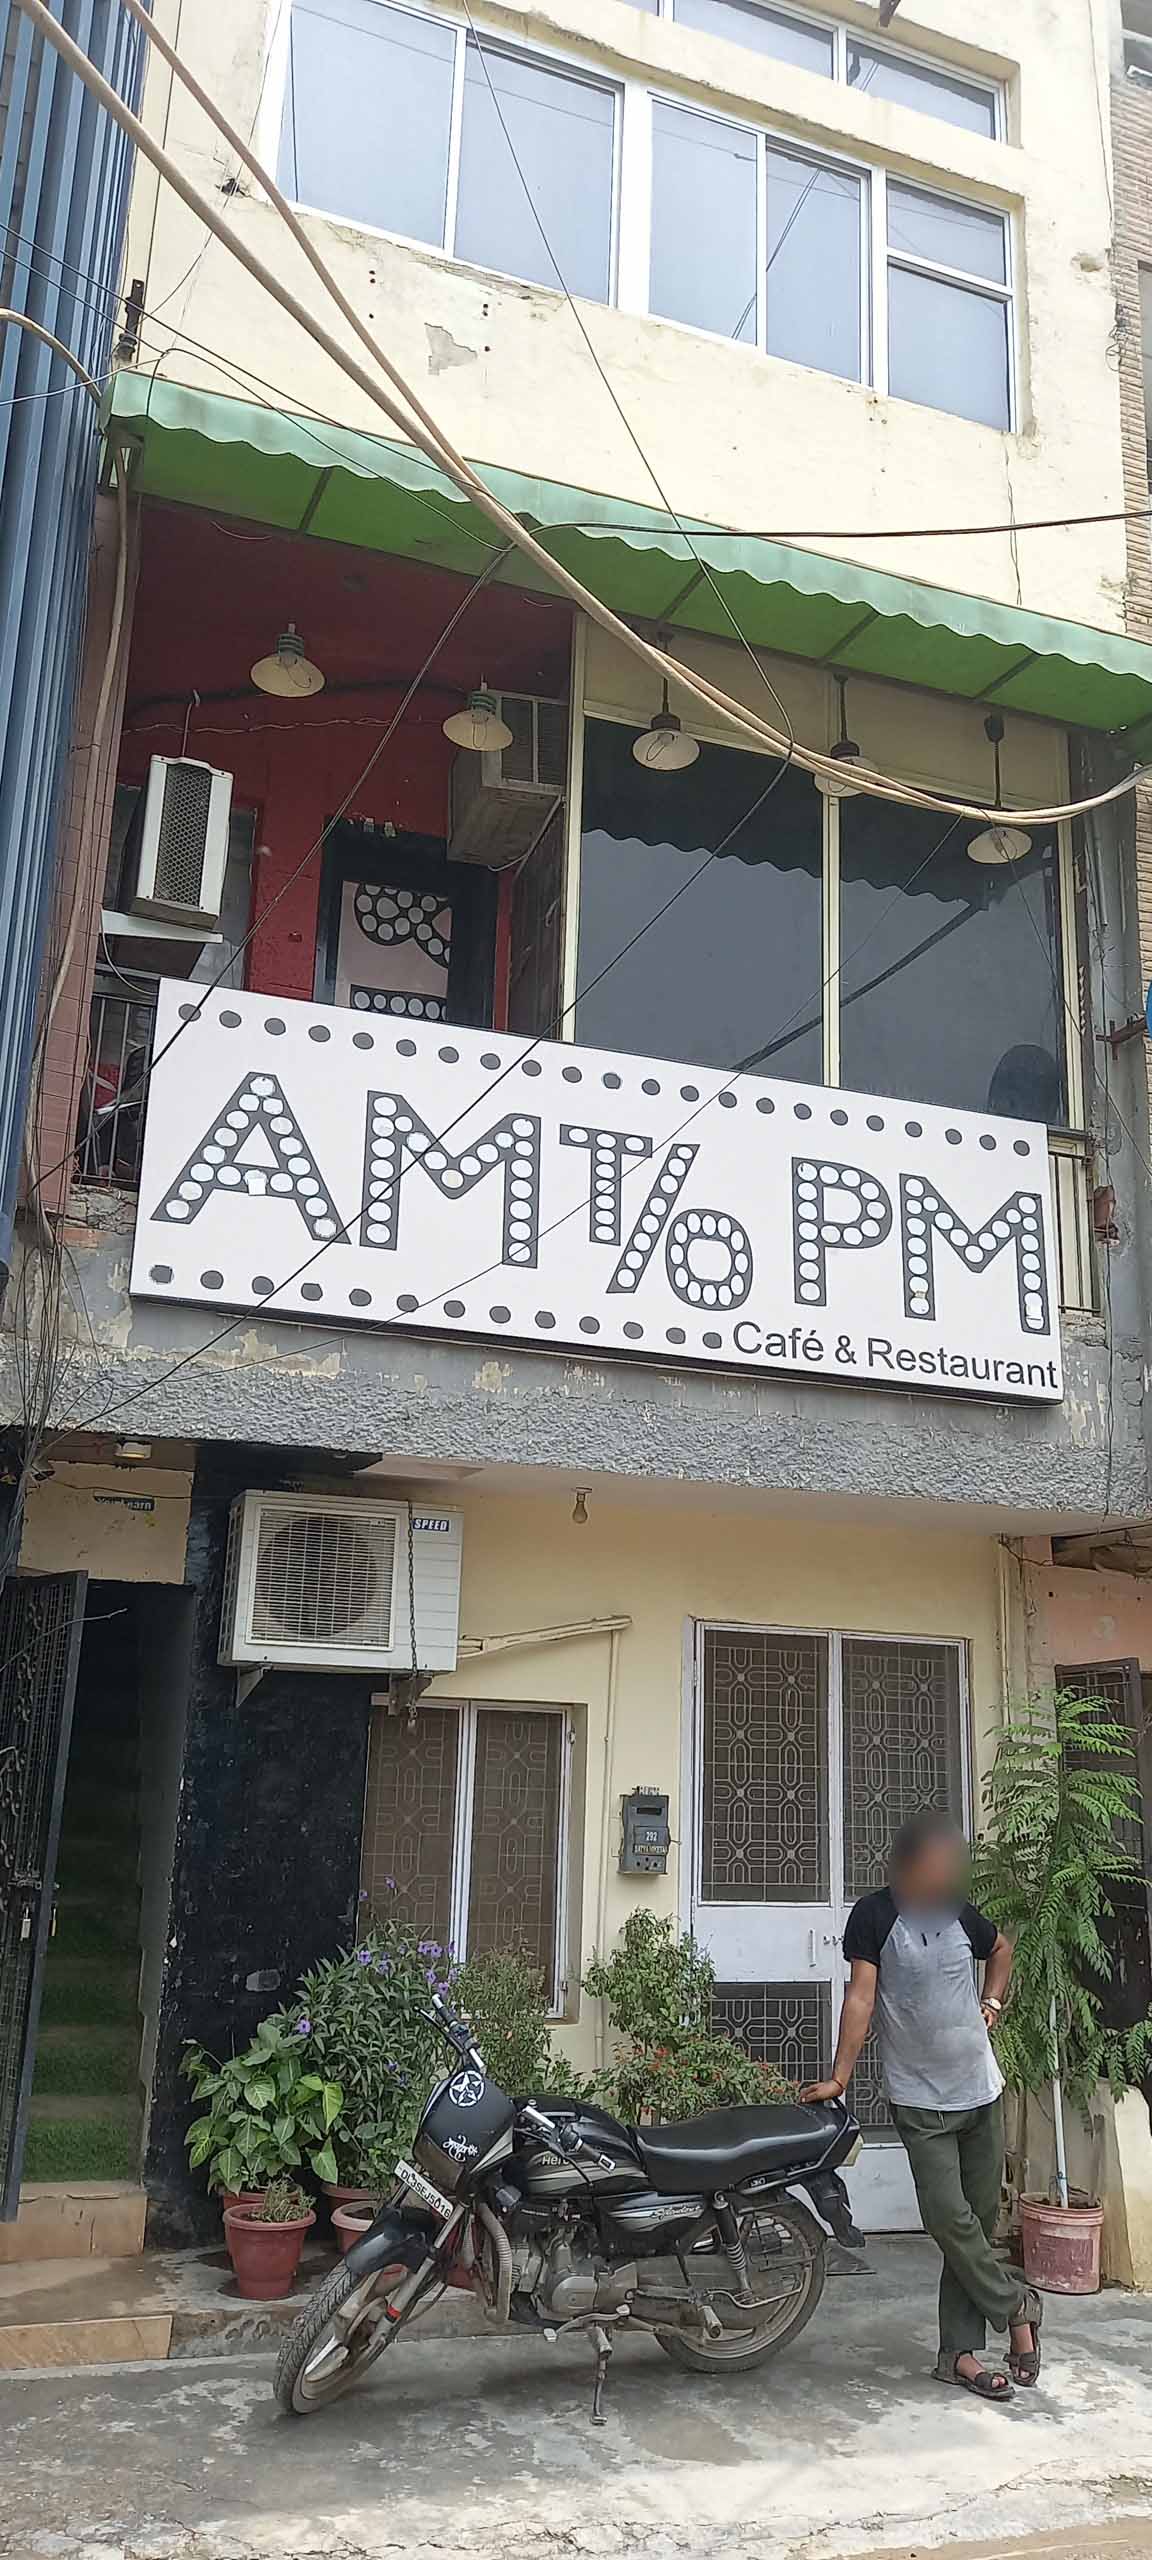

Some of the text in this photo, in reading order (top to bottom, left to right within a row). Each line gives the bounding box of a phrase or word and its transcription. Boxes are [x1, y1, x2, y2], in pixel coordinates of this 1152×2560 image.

[791, 1156, 1051, 1336] PM
[732, 1320, 1059, 1389] Café & Restaurant
[413, 1518, 448, 1531] SPEED
